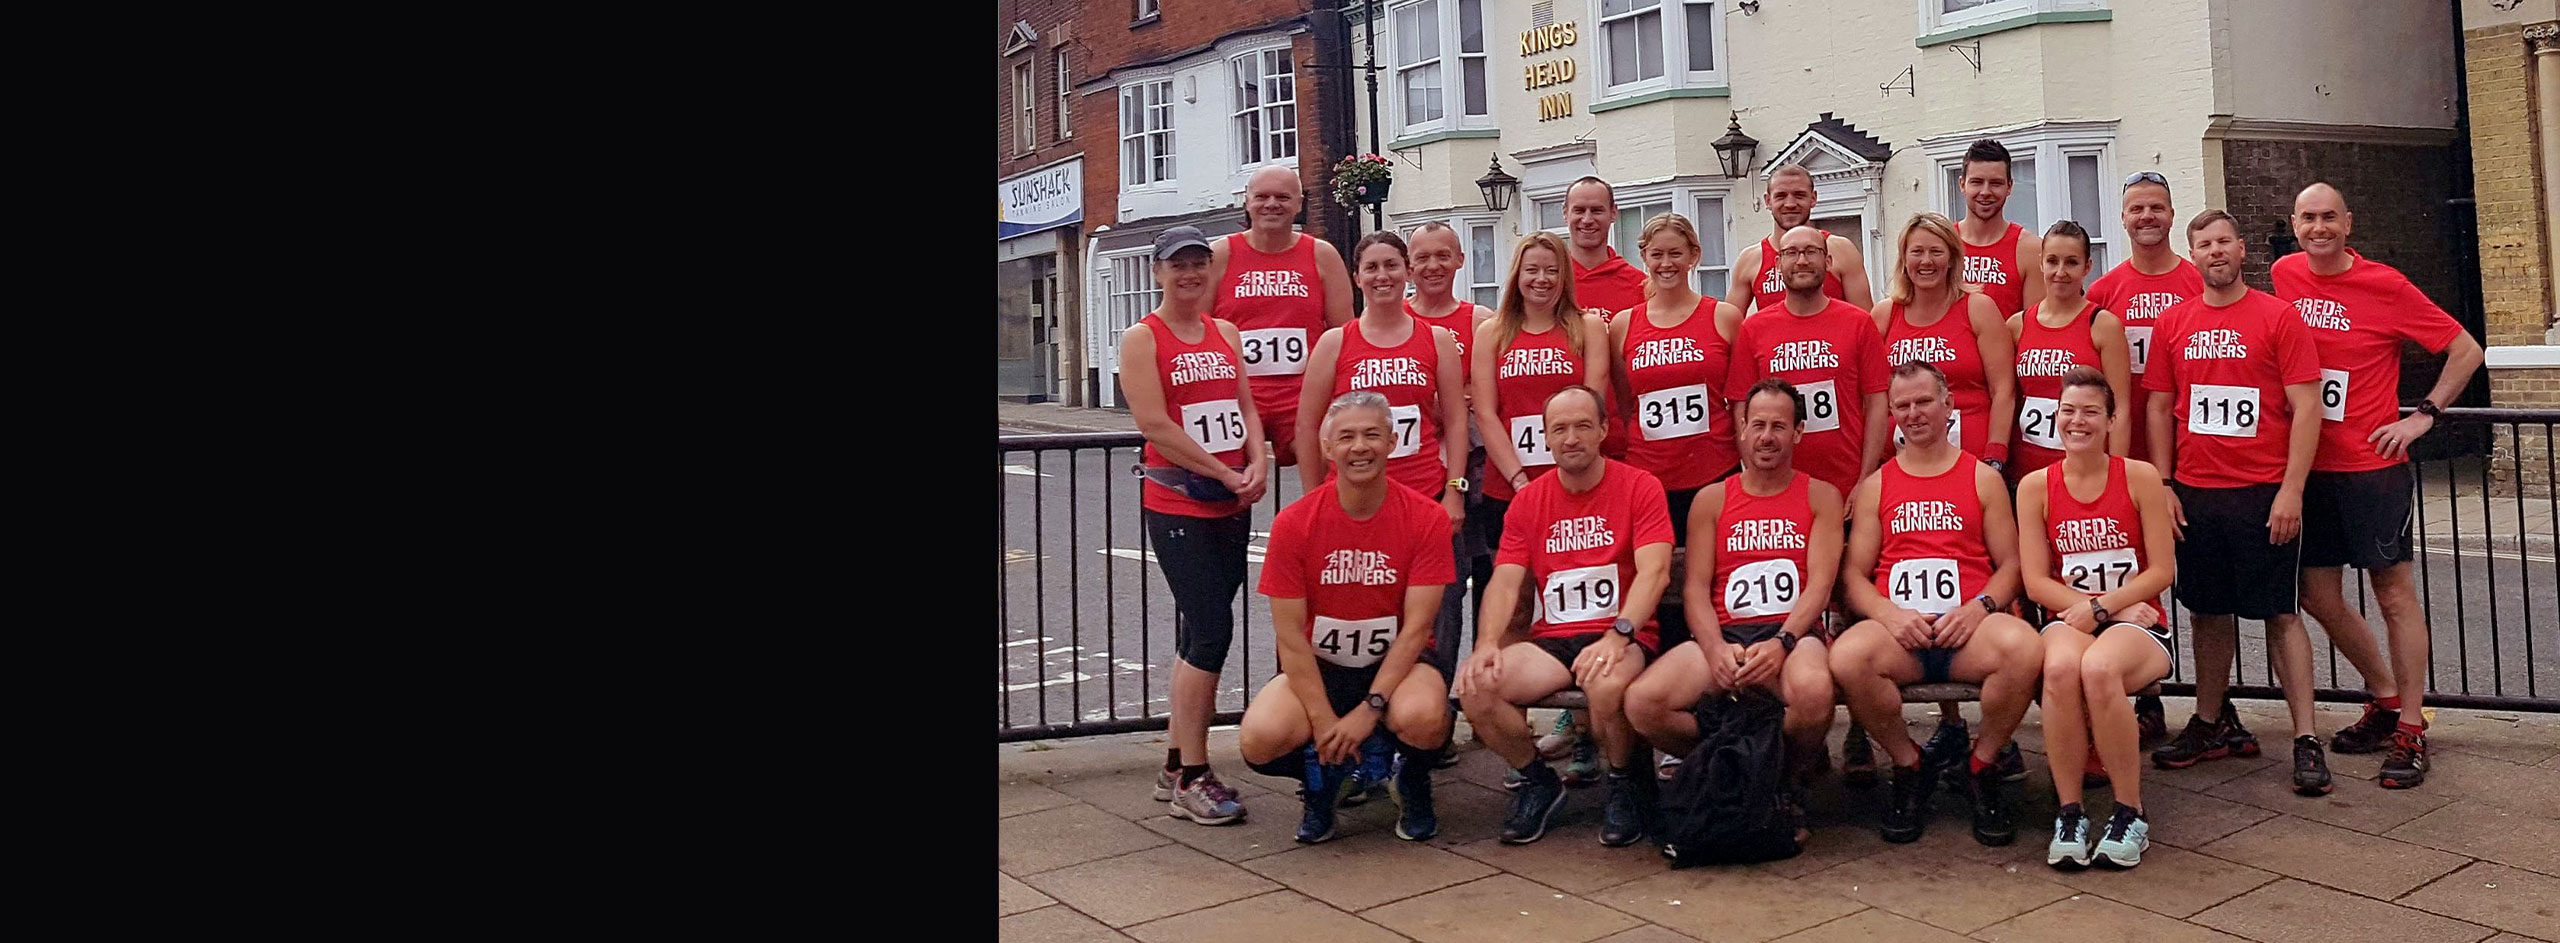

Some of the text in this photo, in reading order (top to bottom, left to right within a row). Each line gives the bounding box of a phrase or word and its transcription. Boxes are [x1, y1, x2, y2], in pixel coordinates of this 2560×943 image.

[1519, 21, 1577, 57] KINGS
[1524, 57, 1576, 91] HEAD
[1538, 92, 1572, 122] INN
[1012, 167, 1071, 209] SUNSHACK
[1252, 271, 1290, 285] RED
[1962, 270, 2007, 285] NNERS
[1234, 284, 1308, 298] RUNNERS
[2139, 292, 2173, 308] RED
[2126, 306, 2167, 320] RUNN
[2301, 298, 2336, 316] RED
[2301, 313, 2351, 332] NNERS
[1646, 337, 1683, 354] RED
[1900, 337, 1936, 353] RED
[2199, 329, 2231, 346] RED
[1243, 337, 1303, 364] 319
[1515, 348, 1553, 363] RED
[1785, 340, 1820, 358] RED
[1887, 348, 1956, 367] RUNNERS
[2028, 349, 2063, 364] RED
[2184, 344, 2247, 360] RUNNERS
[1185, 352, 1219, 367] RED
[1367, 358, 1408, 374] RED
[1632, 349, 1704, 371] RUNNERS
[1770, 354, 1839, 373] RUNNERS
[1171, 366, 1236, 386] RUNNERS
[1500, 361, 1573, 379] RUNNERS
[2017, 363, 2079, 377] RUNNER
[1351, 373, 1427, 390] RUNNERS
[1645, 394, 1704, 428] 315
[1799, 391, 1832, 419] 18
[2197, 397, 2254, 427] 118
[1194, 412, 1243, 443] 115
[2025, 408, 2056, 439] 21
[1906, 500, 1943, 518] RED
[1560, 516, 1596, 537] RED
[1744, 519, 1783, 537] RED
[1891, 515, 1963, 534] RUNNERS
[2066, 518, 2107, 538] RED
[1546, 530, 1614, 553] RUNNERS
[1727, 534, 1805, 552] RUNNERS
[2055, 532, 2128, 552] RUNNERS
[1894, 569, 1955, 601] 416
[2069, 562, 2132, 591] 217
[1553, 579, 1614, 612] 119
[1732, 572, 1794, 609] 219
[1319, 629, 1390, 656] 415
